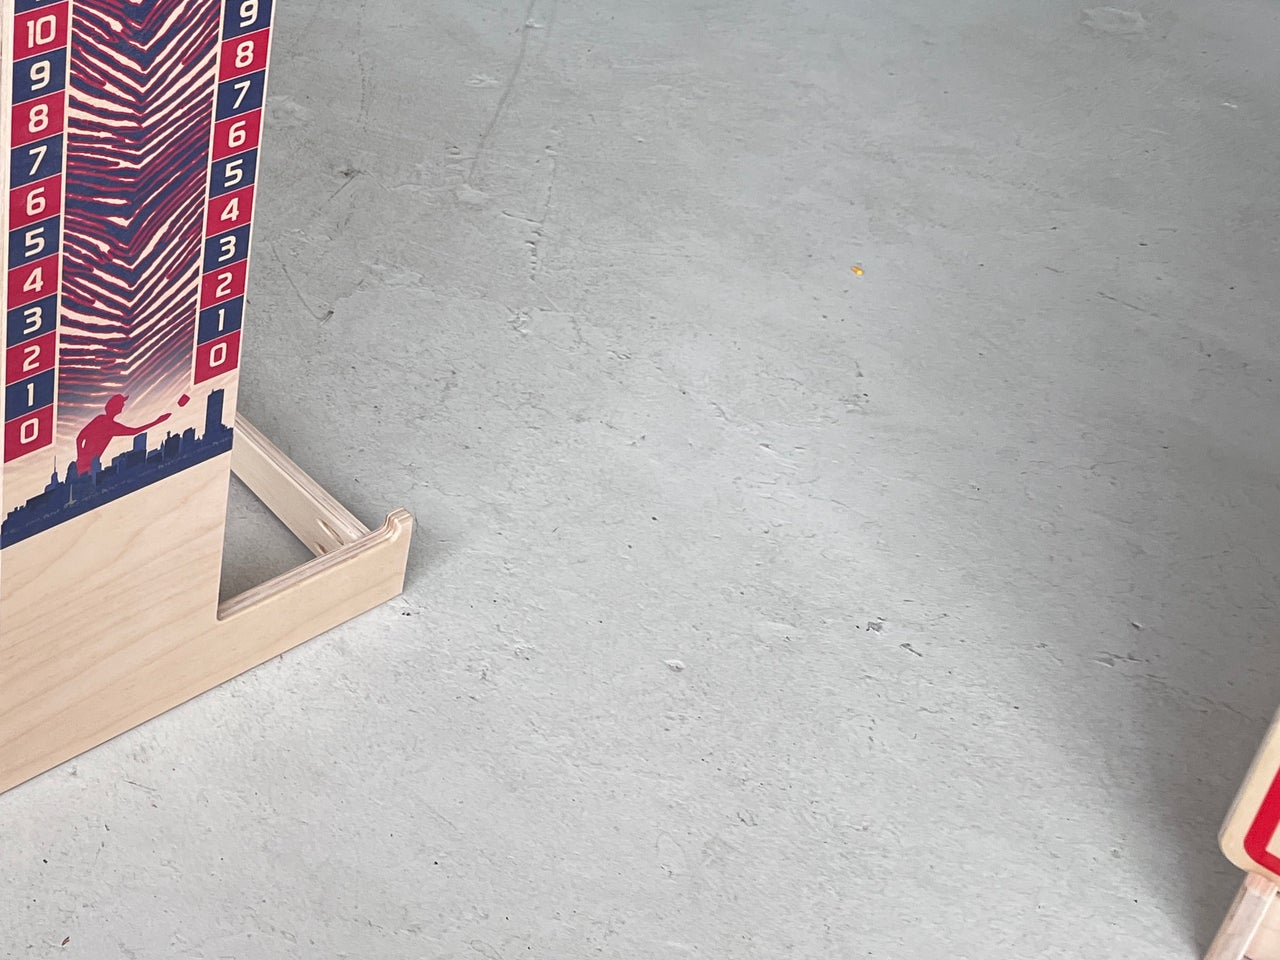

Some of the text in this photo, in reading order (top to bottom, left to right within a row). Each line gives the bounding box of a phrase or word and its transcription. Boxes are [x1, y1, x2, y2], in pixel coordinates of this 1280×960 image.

[26, 14, 57, 49] 10
[235, 40, 255, 68] 8
[29, 59, 51, 91] 9
[232, 79, 251, 110] 7
[28, 103, 49, 133] 8
[228, 120, 246, 148] 6
[28, 144, 48, 176] 7
[224, 158, 244, 188] 5
[26, 186, 46, 216] 6
[220, 197, 240, 222] 4
[24, 226, 45, 258] 5
[217, 235, 237, 262] 3
[23, 266, 44, 292] 4
[215, 271, 233, 298] 2
[23, 306, 43, 335] 3
[218, 308, 225, 332] 1
[22, 345, 41, 372] 2
[209, 342, 227, 368] 0
[26, 382, 34, 407] 1
[20, 417, 39, 444] 0
